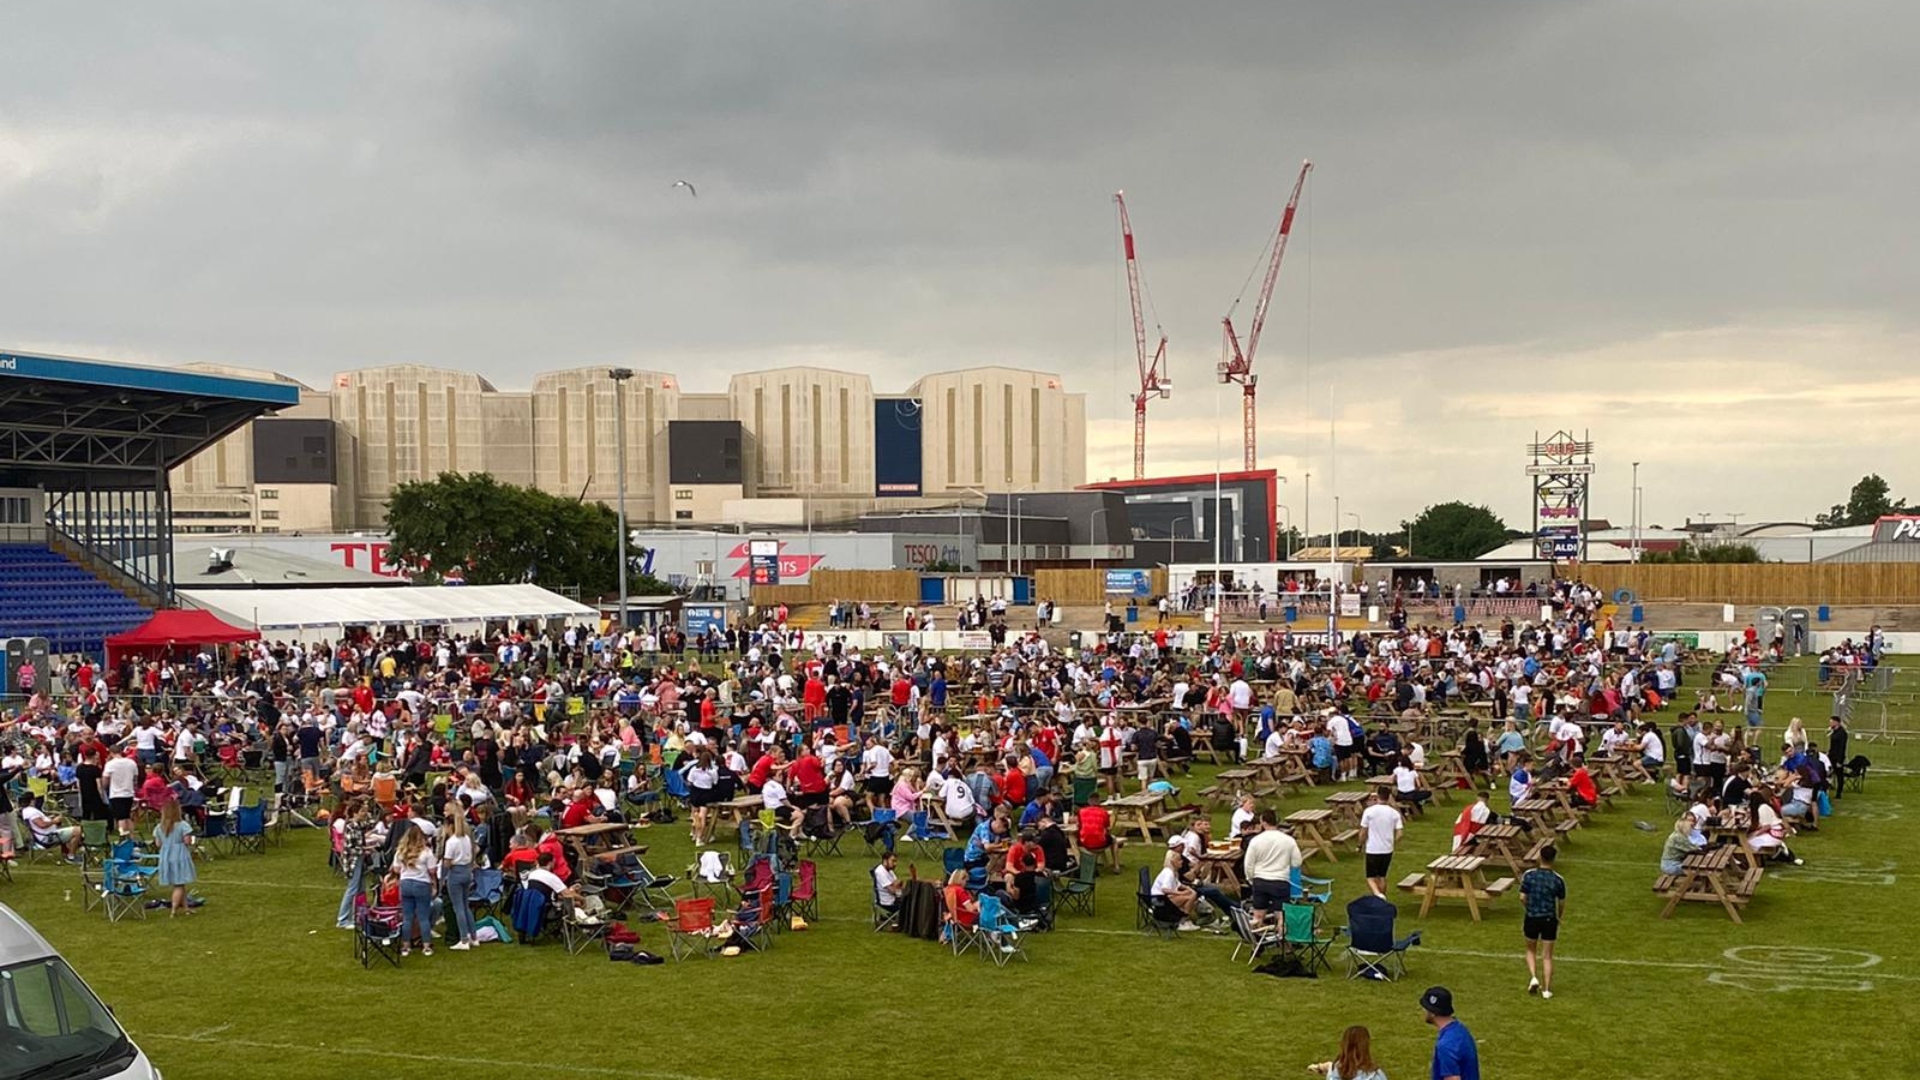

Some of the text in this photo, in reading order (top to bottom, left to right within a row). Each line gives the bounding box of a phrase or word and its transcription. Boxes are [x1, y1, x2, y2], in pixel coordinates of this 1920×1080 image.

[0, 357, 17, 370] nd
[1554, 542, 1577, 552] ALDI
[903, 544, 938, 564] TESCO
[957, 786, 966, 799] 9
